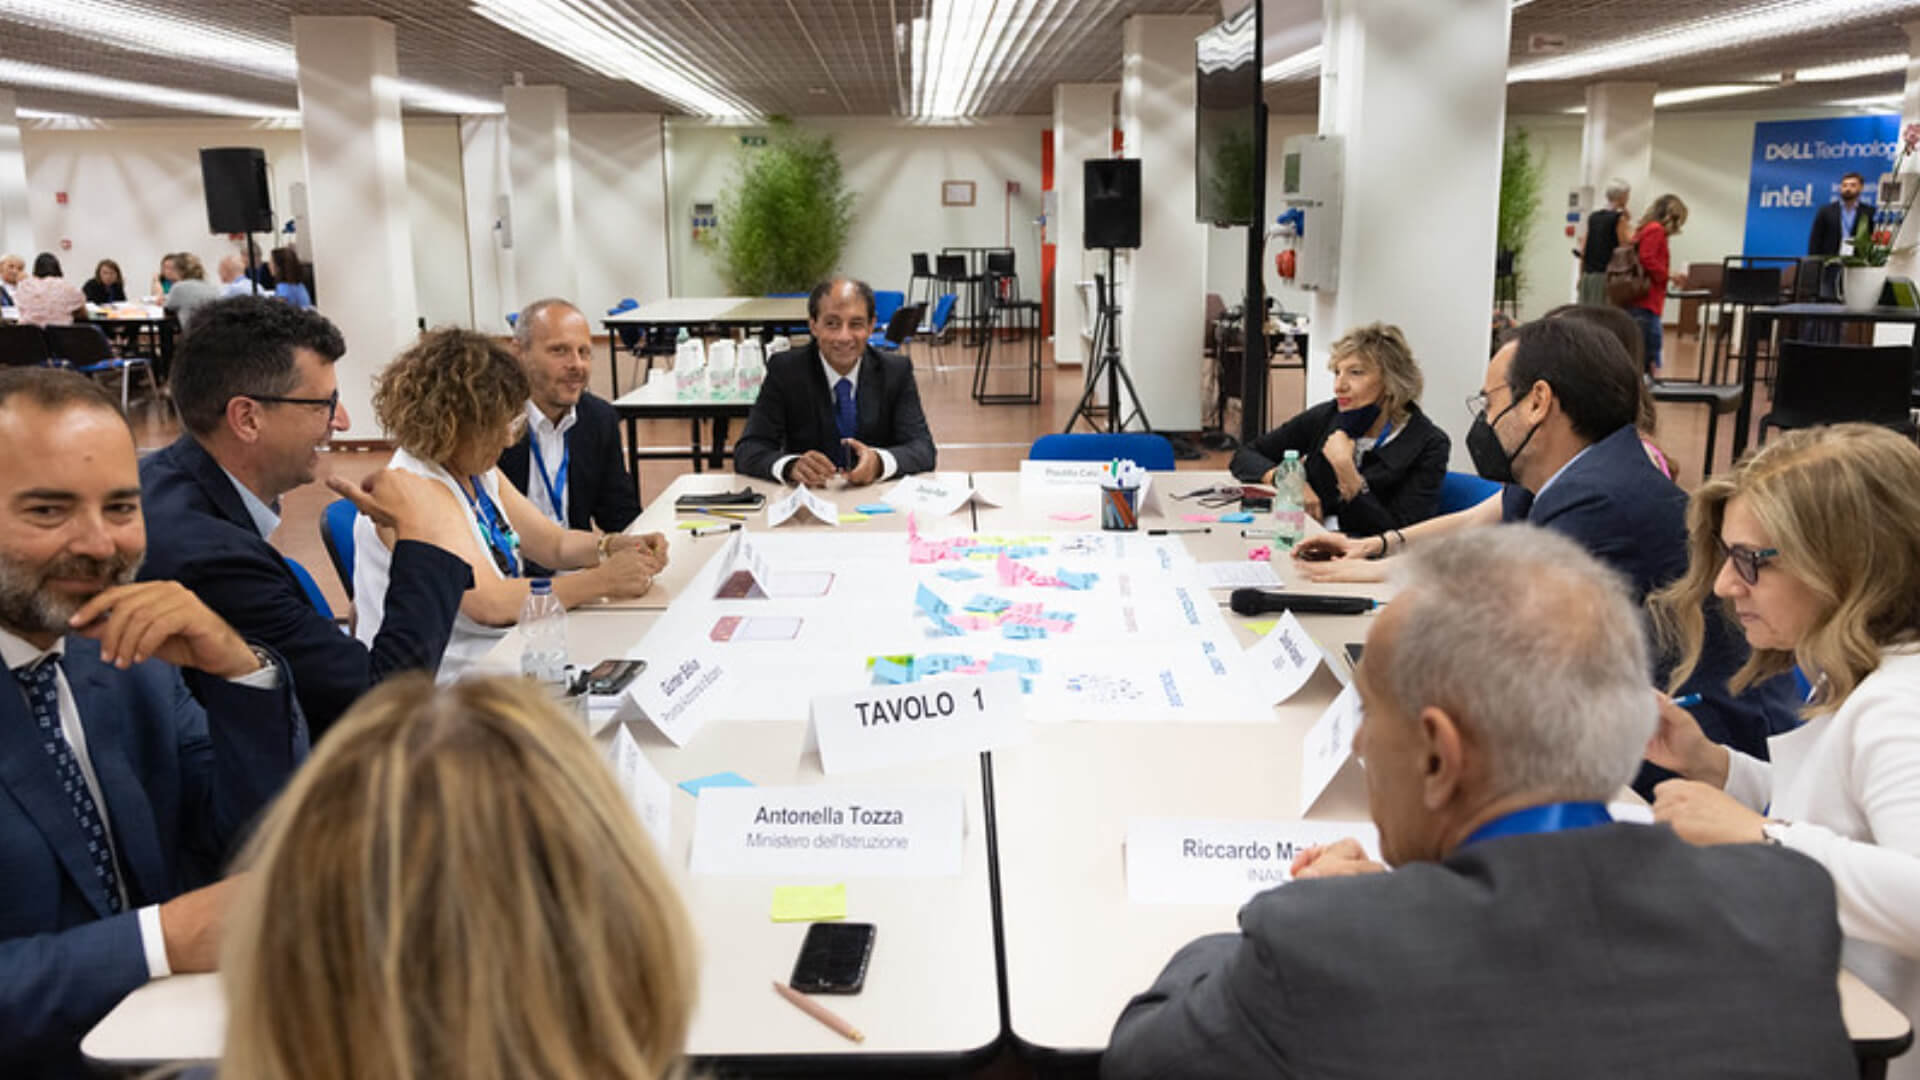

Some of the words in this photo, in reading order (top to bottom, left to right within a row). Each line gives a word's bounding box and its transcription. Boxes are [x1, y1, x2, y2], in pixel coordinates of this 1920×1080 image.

[1766, 143, 1813, 160] DELL
[1760, 184, 1814, 208] intel
[855, 691, 955, 727] TAVOLO
[972, 687, 985, 712] 1
[754, 806, 844, 825] Antonella
[849, 806, 905, 825] Tozza
[746, 833, 810, 850] Ministero
[1183, 839, 1271, 861] Riccardo
